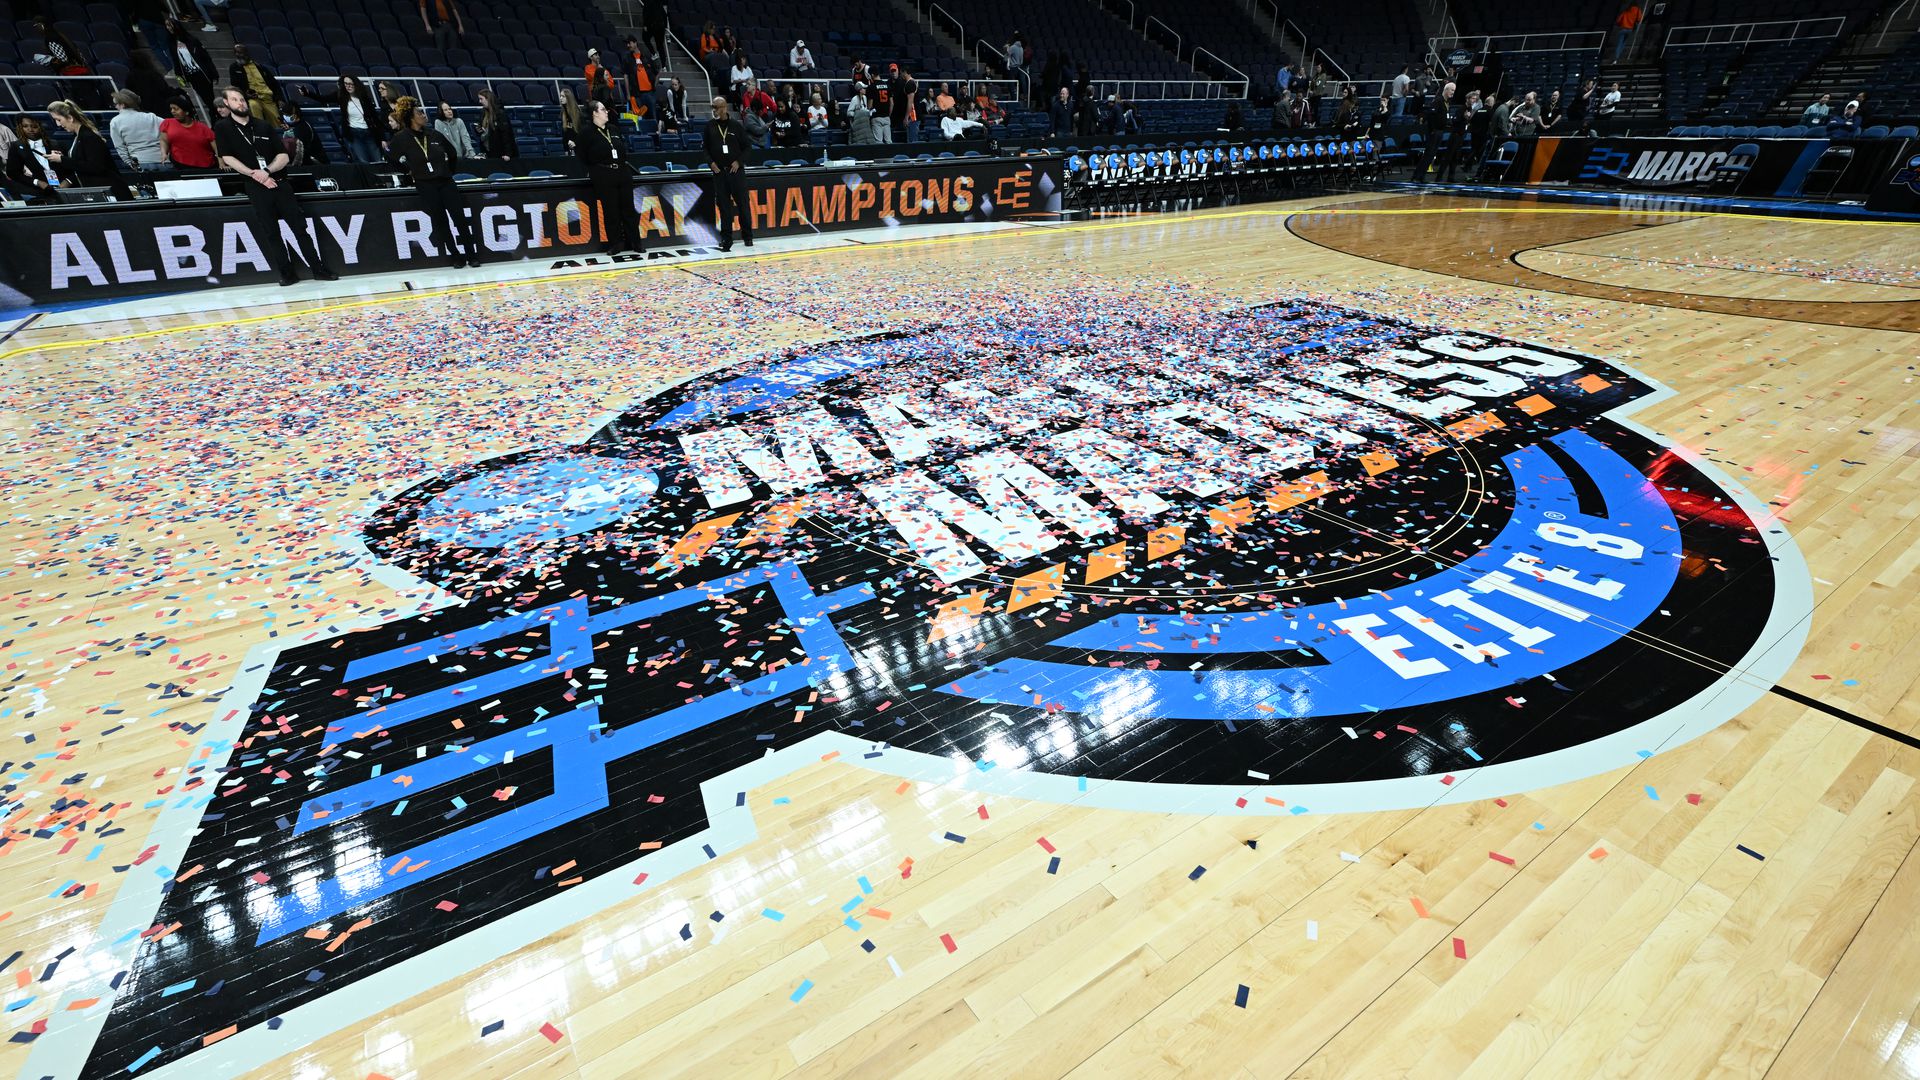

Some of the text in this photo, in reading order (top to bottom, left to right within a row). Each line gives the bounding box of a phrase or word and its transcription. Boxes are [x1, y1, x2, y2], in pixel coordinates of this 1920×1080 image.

[1626, 150, 1750, 183] MARCH
[391, 193, 690, 260] RGIOAL
[862, 333, 1587, 584] MADNESS
[1331, 521, 1645, 681] ELITE 8
